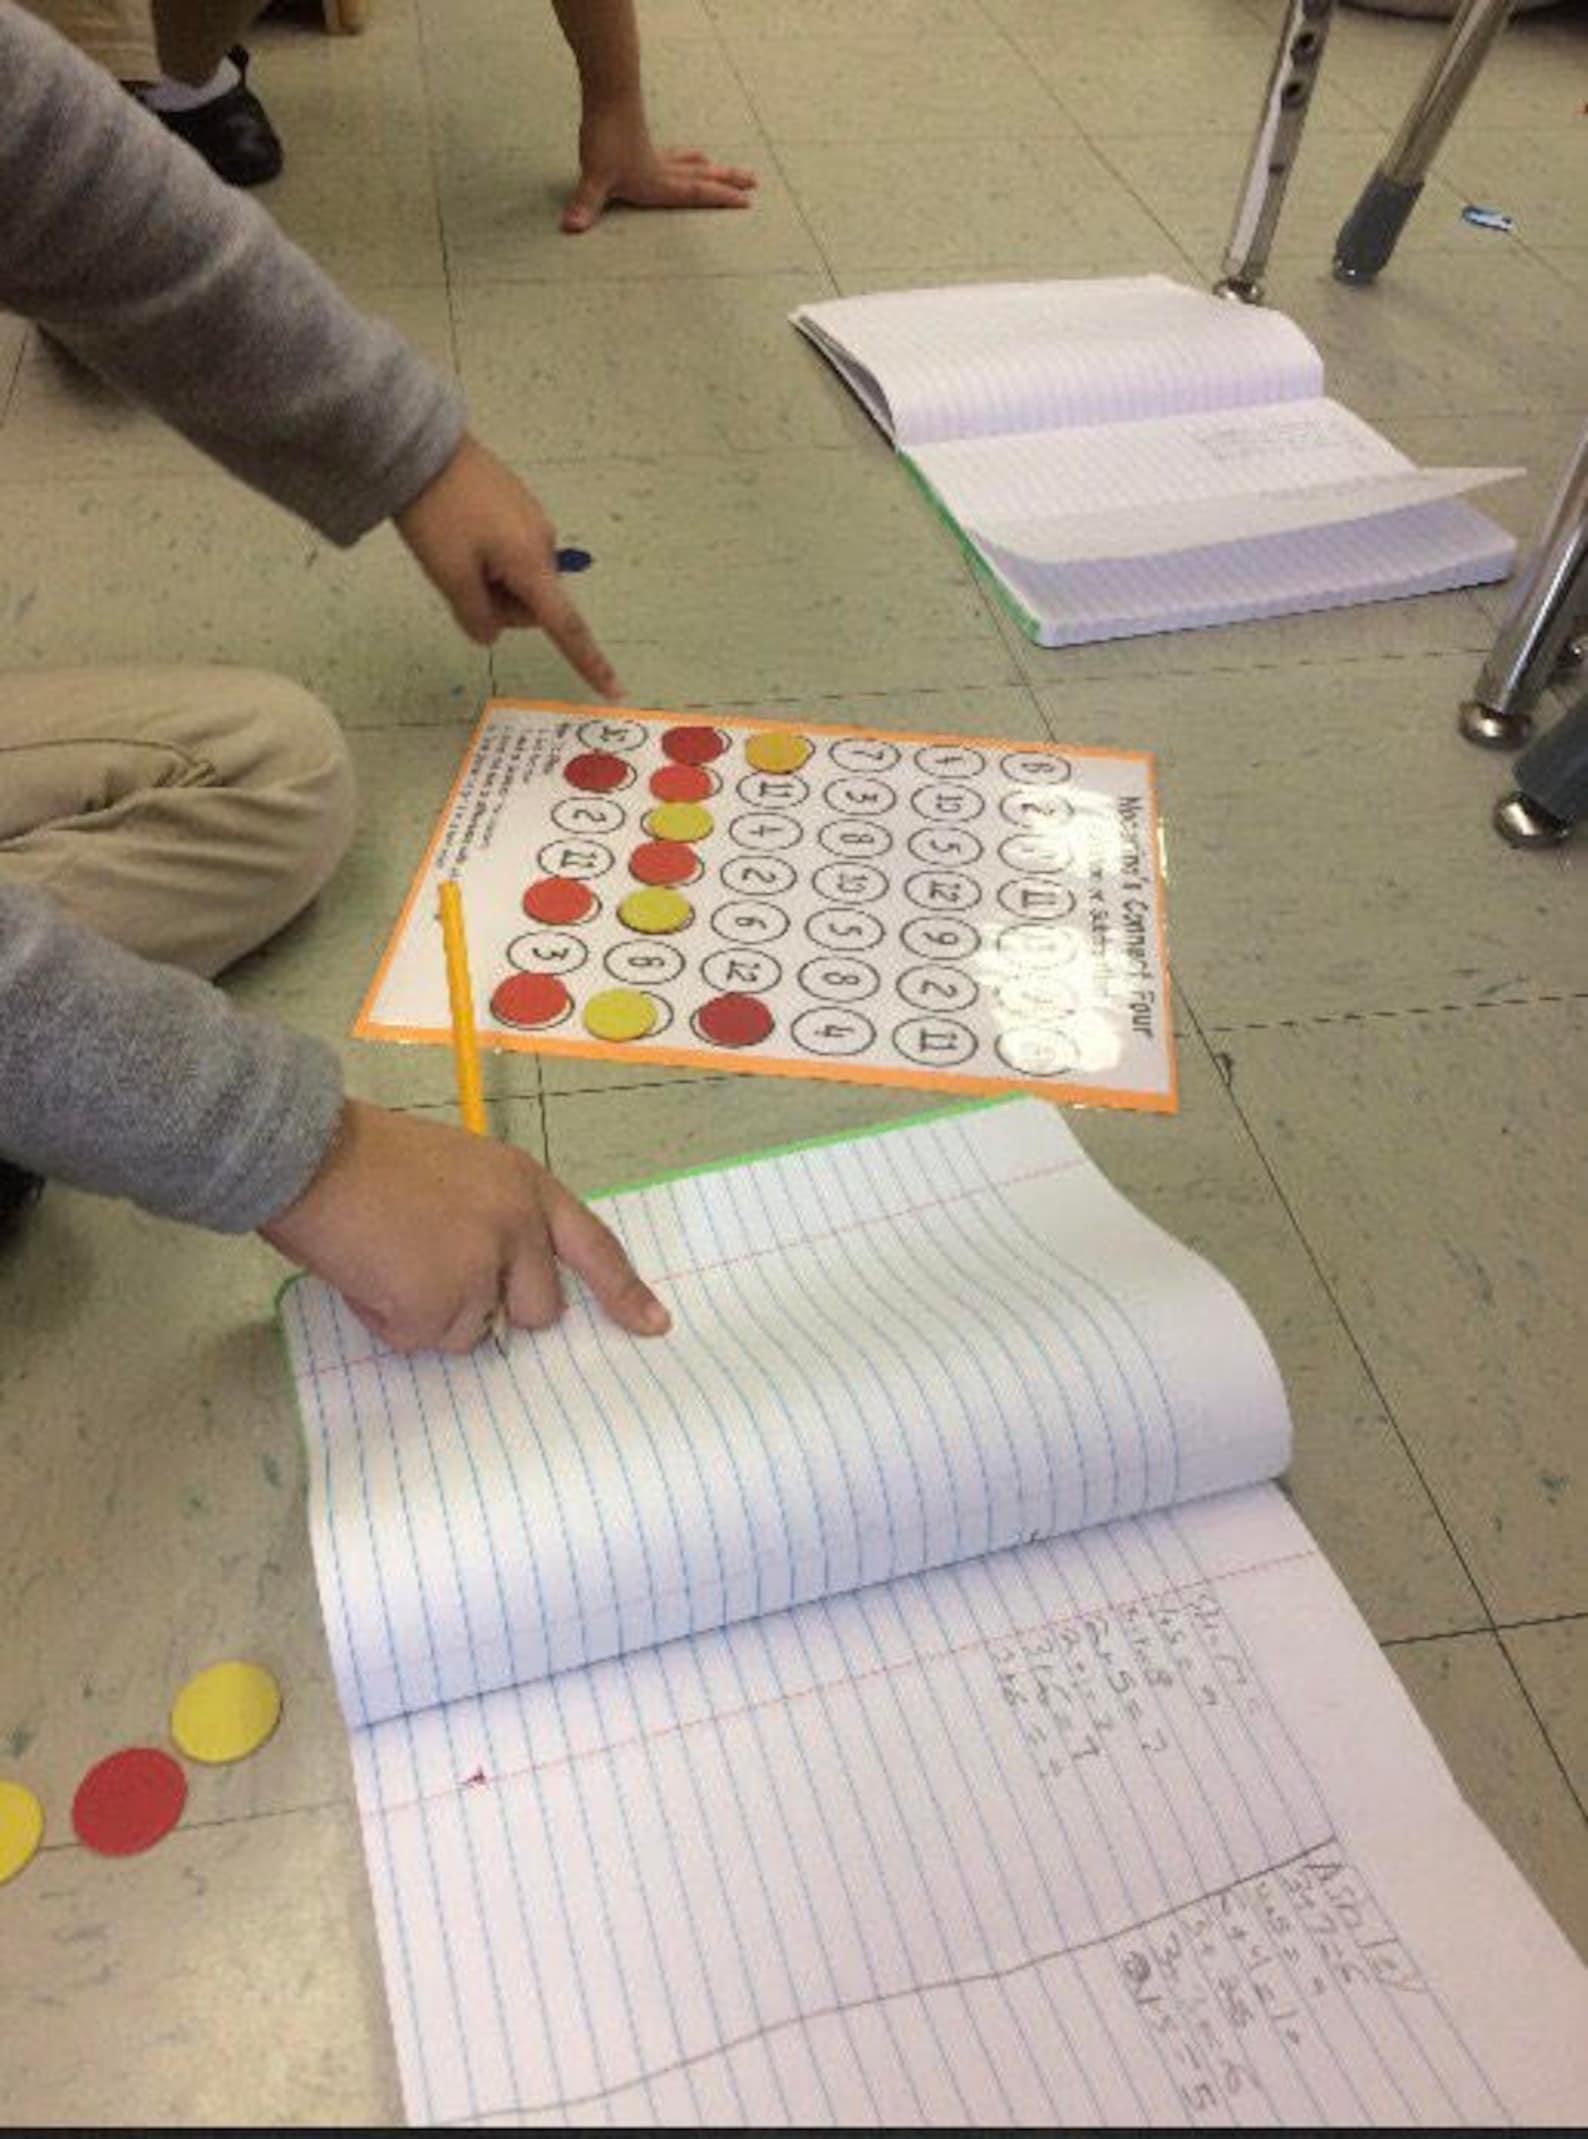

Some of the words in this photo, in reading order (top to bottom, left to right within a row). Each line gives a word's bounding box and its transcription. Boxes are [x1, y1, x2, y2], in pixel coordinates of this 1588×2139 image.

[850, 748, 886, 762] 7
[758, 779, 794, 799] 11
[844, 789, 880, 805] 3
[934, 792, 965, 814] 10
[1017, 802, 1057, 817] 2
[571, 808, 608, 824] 2
[747, 823, 785, 839] 4
[839, 832, 876, 846] 8
[928, 838, 962, 855] 5
[561, 848, 597, 868] 11
[740, 866, 779, 885] 2
[835, 871, 870, 895] 10
[927, 879, 962, 904] 12
[1020, 888, 1058, 910] 11
[733, 915, 768, 931] 6
[827, 922, 864, 937] 5
[921, 930, 961, 947] 9
[1122, 899, 1153, 979] Connect
[532, 946, 570, 962] 3
[725, 958, 762, 984] 12
[820, 970, 862, 987] 8
[918, 978, 959, 1000] 2
[1128, 990, 1155, 1039] Four
[813, 1023, 856, 1039] 4
[917, 1027, 959, 1054] 11
